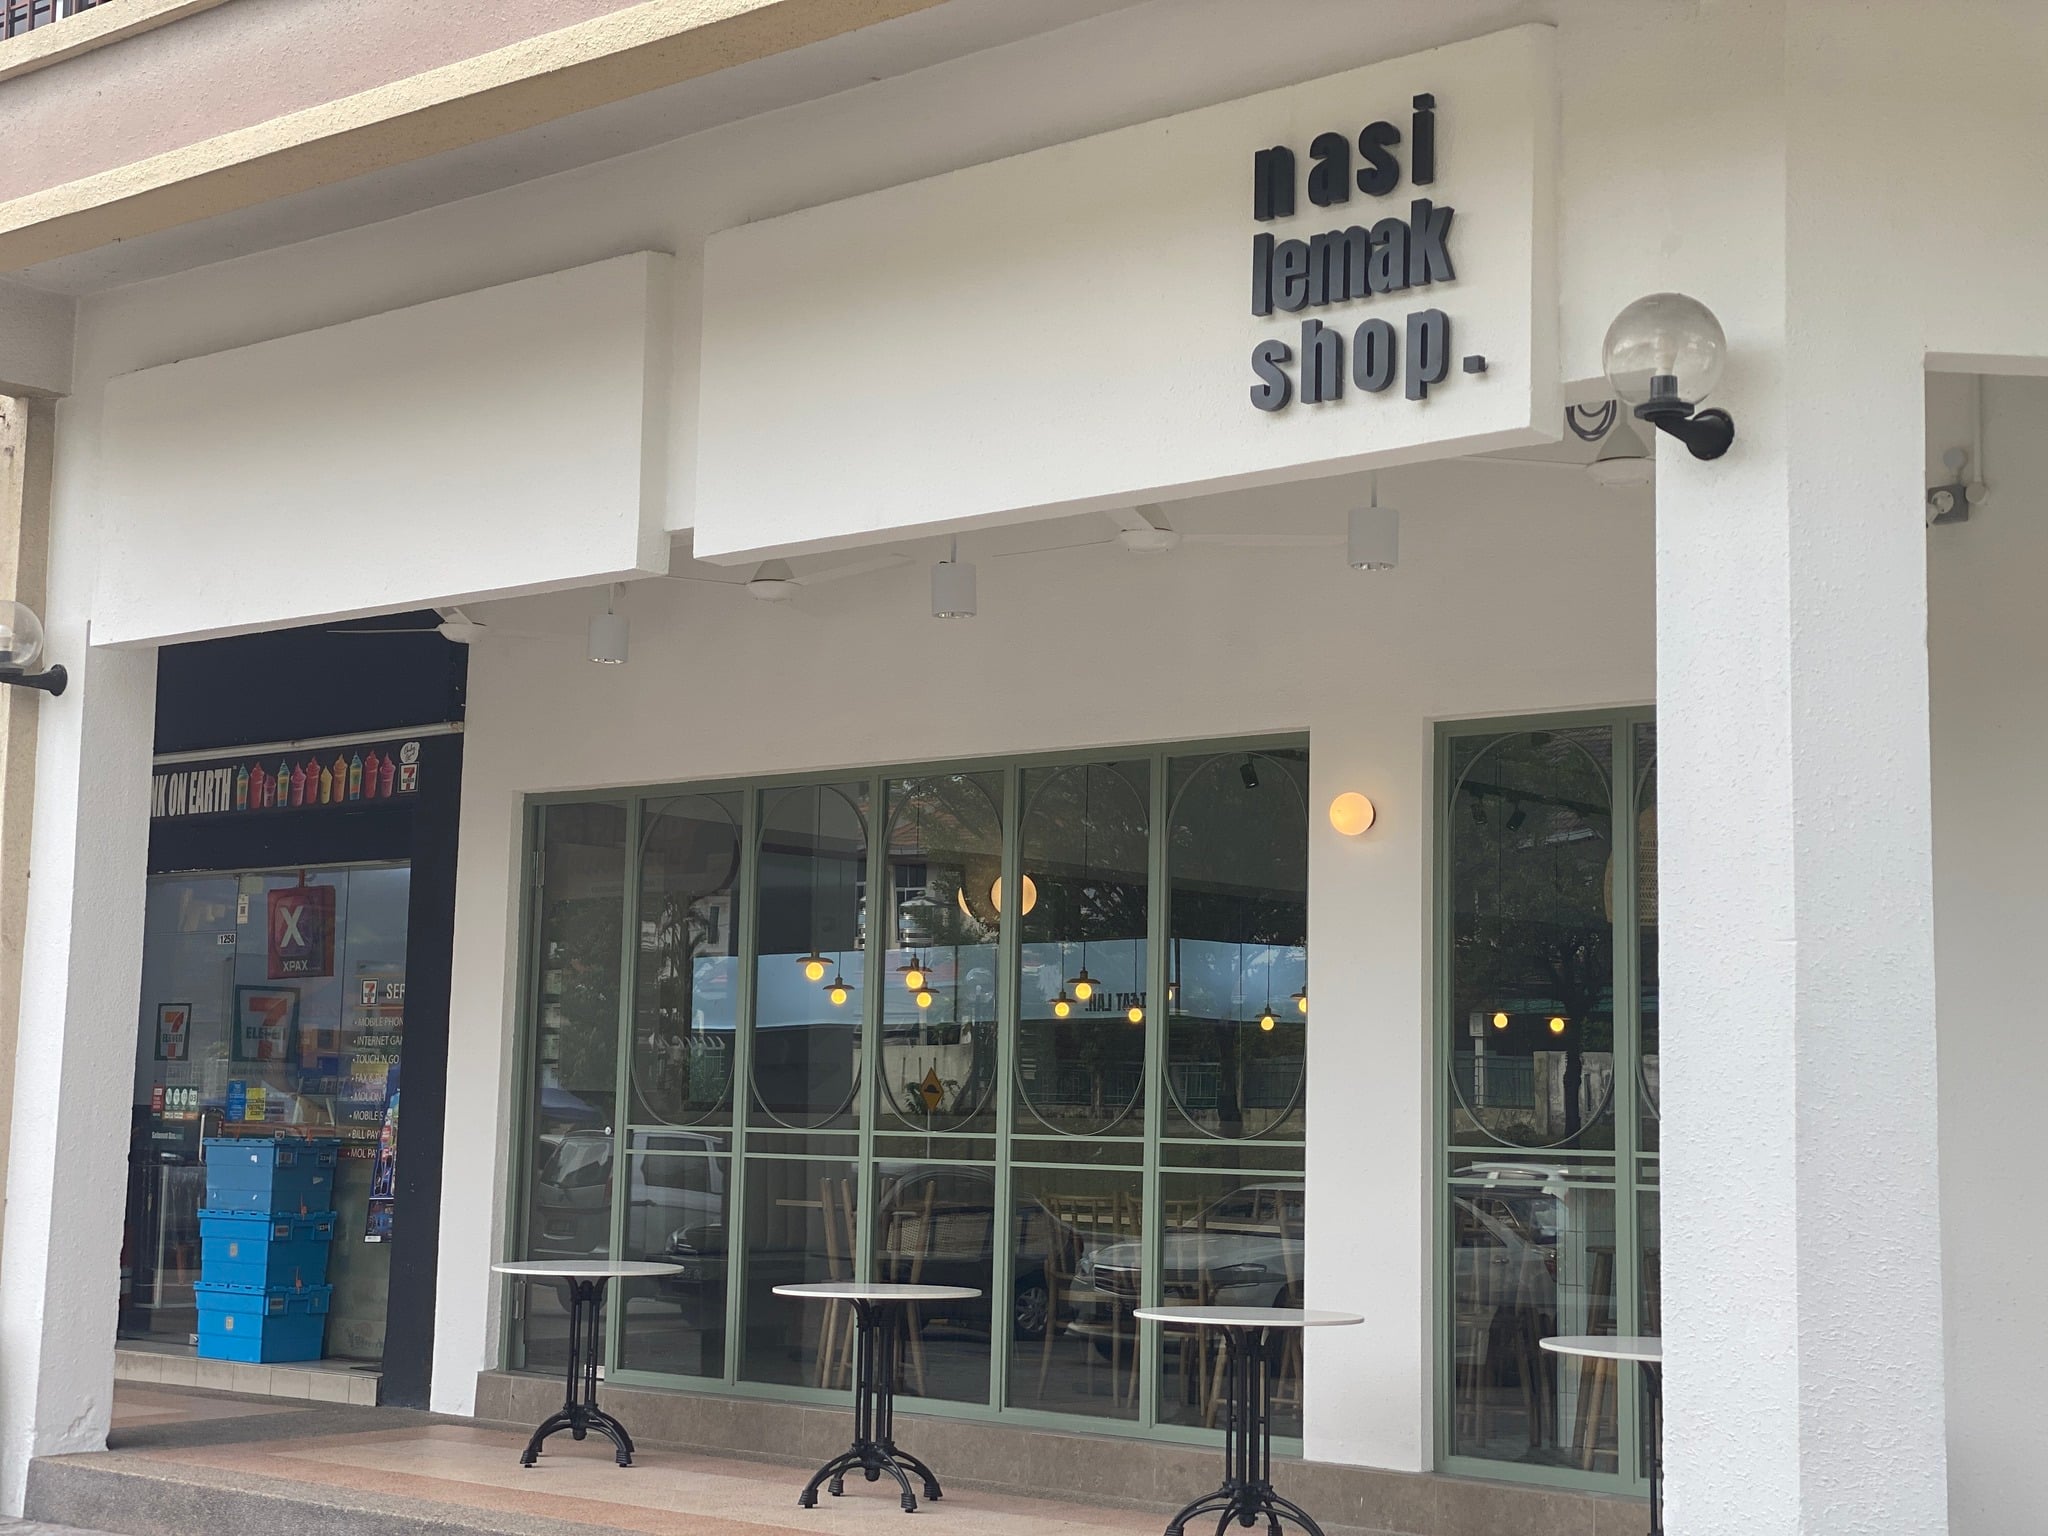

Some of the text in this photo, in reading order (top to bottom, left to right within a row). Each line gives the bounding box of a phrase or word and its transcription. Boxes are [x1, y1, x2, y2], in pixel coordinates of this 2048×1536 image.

[1254, 92, 1435, 221] nasi
[1251, 198, 1455, 316] lemak
[1249, 308, 1486, 412] shop.
[168, 772, 188, 817] ON
[188, 767, 232, 815] EARTH
[282, 959, 309, 972] XPAX
[357, 1035, 389, 1047] INTERNET
[355, 1054, 379, 1065] TOUCH
[388, 1054, 400, 1065] GO
[353, 1110, 378, 1121] MOBILE
[351, 1128, 365, 1139] BILL
